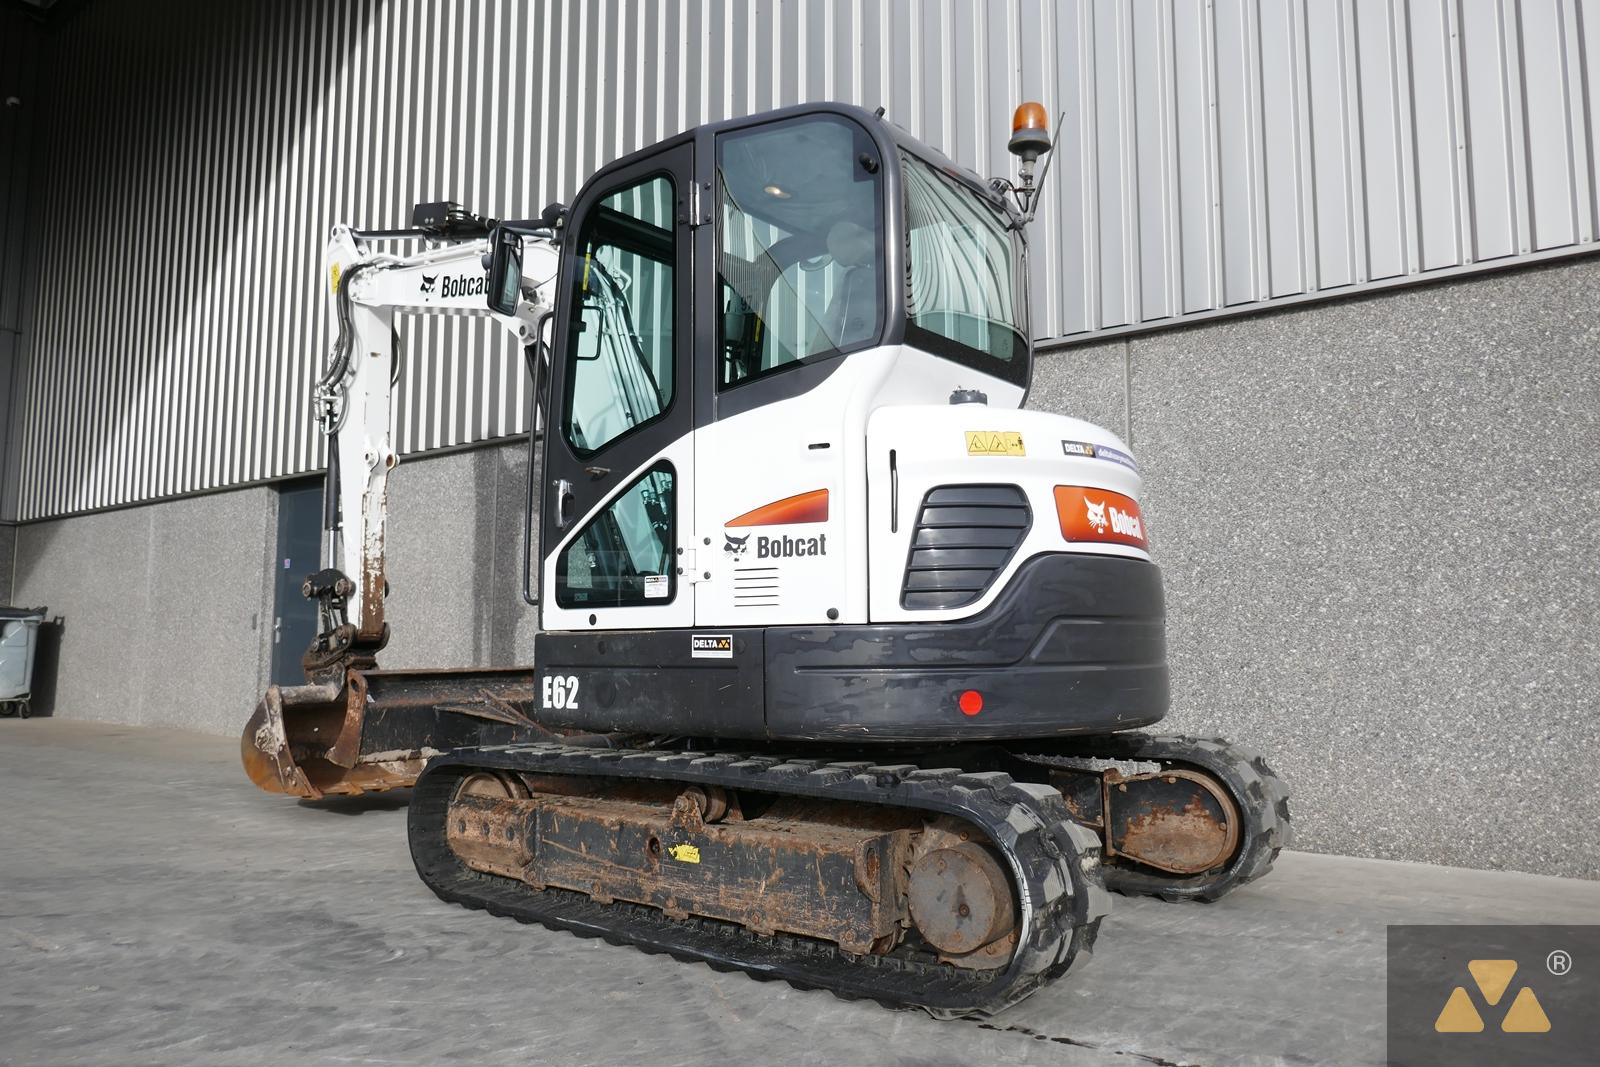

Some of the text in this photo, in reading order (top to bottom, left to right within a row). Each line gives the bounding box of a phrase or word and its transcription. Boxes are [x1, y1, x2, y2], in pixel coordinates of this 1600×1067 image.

[1064, 443, 1086, 454] DELTA
[1108, 506, 1144, 540] Bobcat
[757, 534, 827, 559] Bobcat
[694, 639, 718, 649] DELTA
[542, 675, 579, 710] E62
